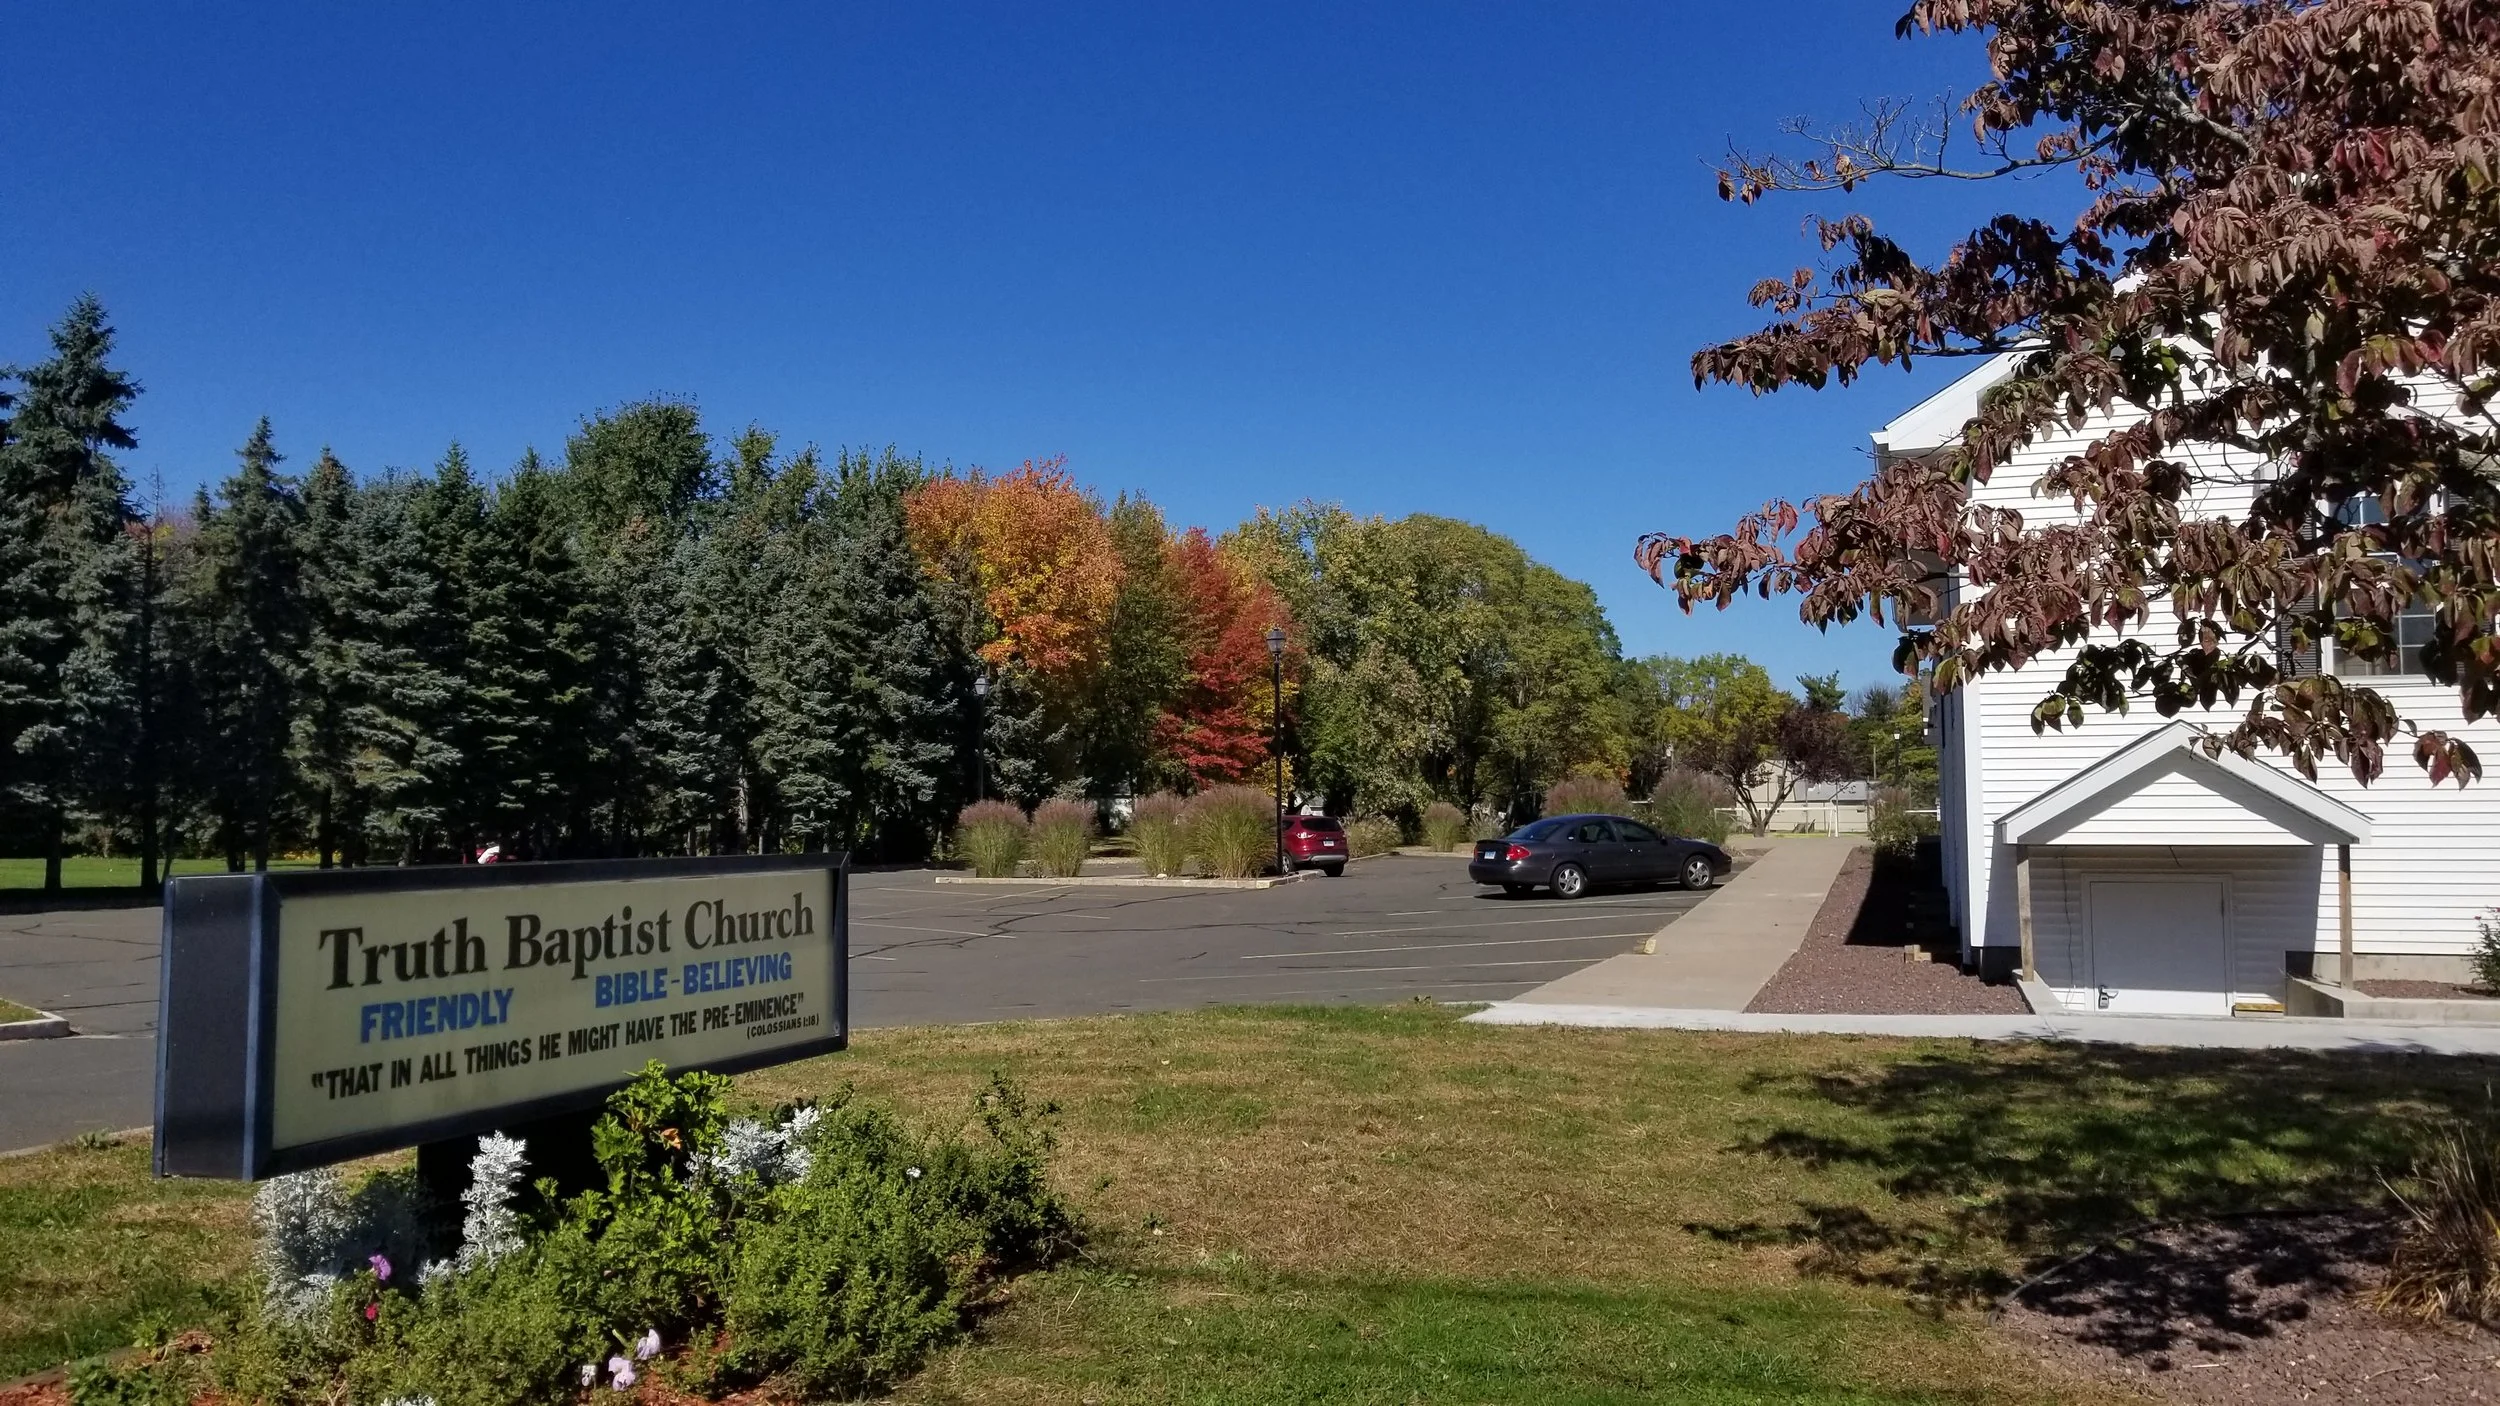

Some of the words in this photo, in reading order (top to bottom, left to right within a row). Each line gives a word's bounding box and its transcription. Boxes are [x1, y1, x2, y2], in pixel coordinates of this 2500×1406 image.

[318, 916, 488, 990] Truth
[503, 905, 672, 981] Baptist
[684, 892, 814, 950] Church
[360, 987, 514, 1043] FRIENDLY
[595, 951, 792, 1008] BIBLE-BELIEVING
[746, 1018, 802, 1040] (COLOSSIANS
[311, 1063, 383, 1100] "THAT
[390, 1058, 412, 1089] IN
[419, 1051, 457, 1084] ALL
[464, 1038, 532, 1075] THINGS
[539, 1033, 561, 1061] HE
[567, 1023, 620, 1056] MIGHT
[625, 1015, 664, 1045] HAVE
[669, 1010, 697, 1037] THE
[702, 992, 804, 1031] PRE-EMINENCE"
